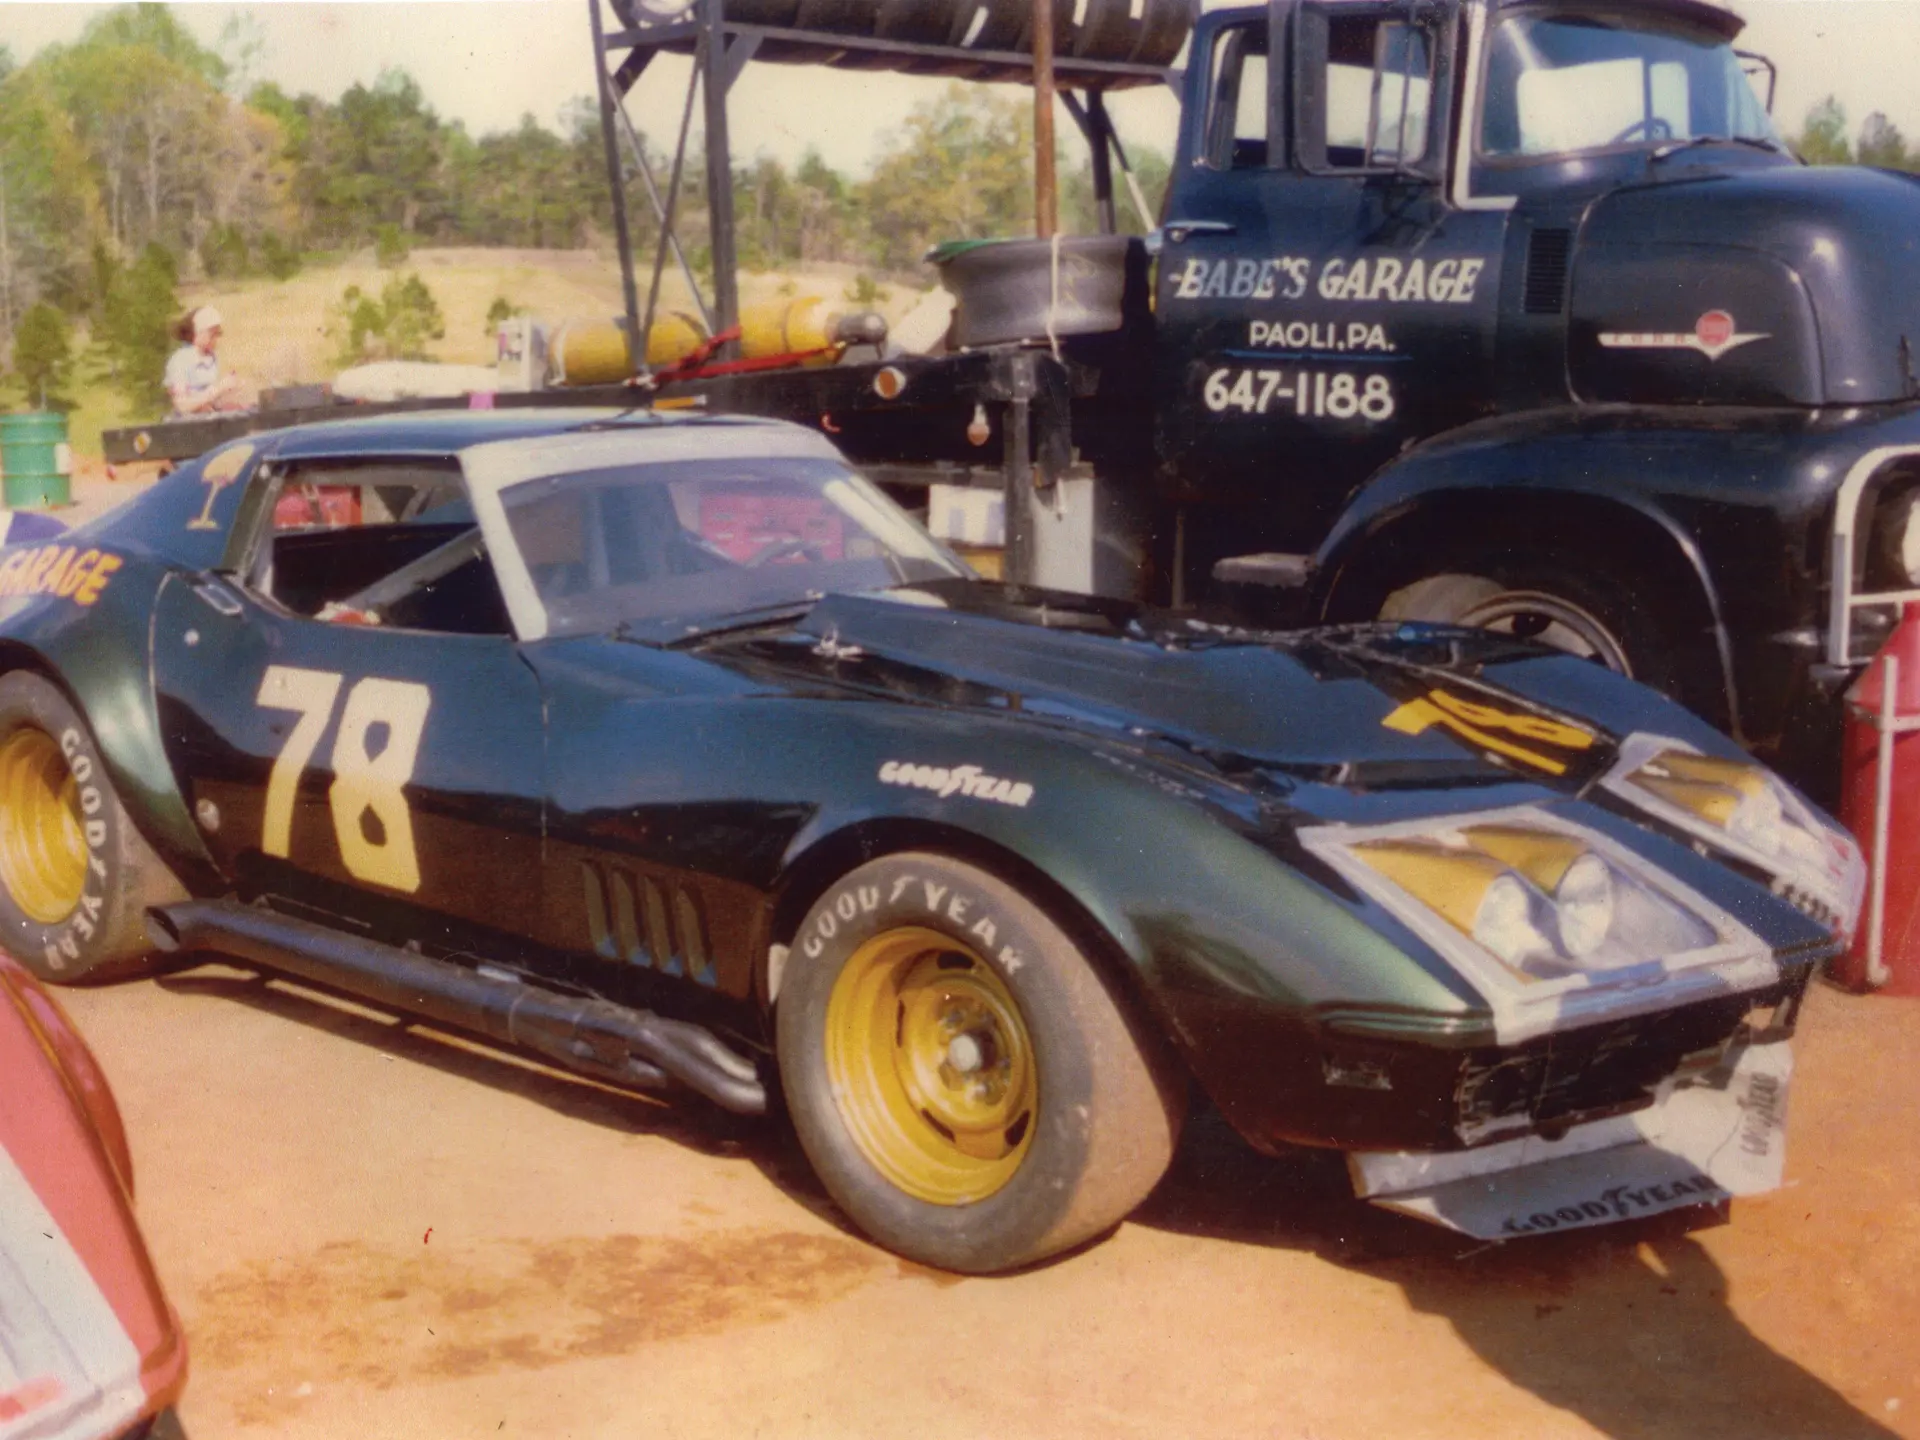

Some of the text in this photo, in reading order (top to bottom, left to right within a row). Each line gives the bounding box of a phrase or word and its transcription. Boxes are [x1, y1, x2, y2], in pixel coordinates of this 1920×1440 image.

[1317, 257, 1484, 303] GARAGE
[1204, 368, 1395, 421] 647-1188
[257, 664, 431, 893] 78
[877, 760, 1035, 807] GOODYEAR
